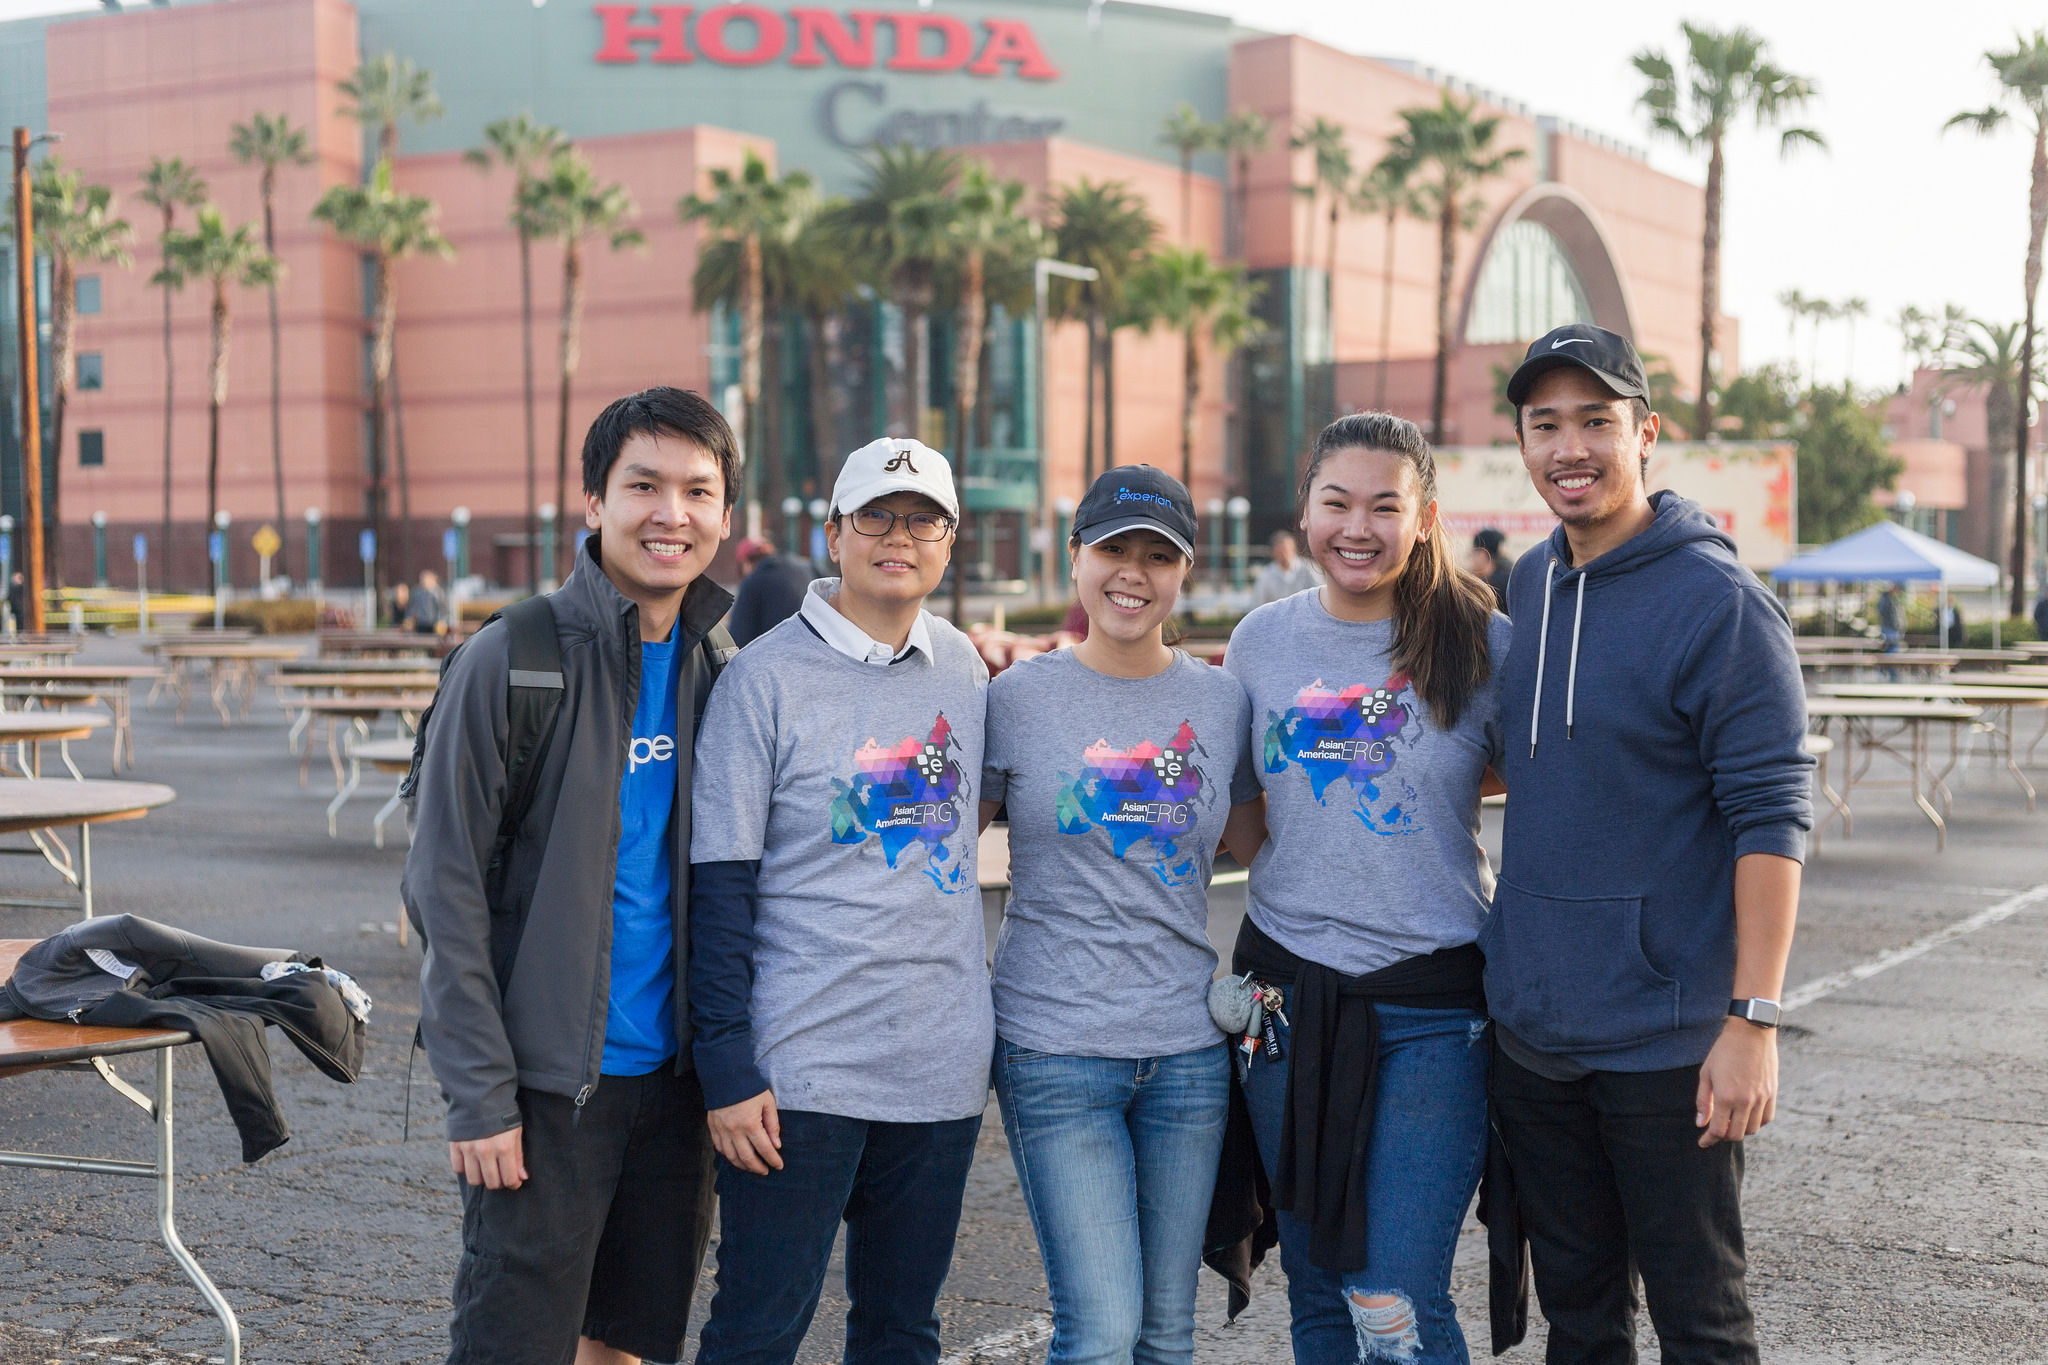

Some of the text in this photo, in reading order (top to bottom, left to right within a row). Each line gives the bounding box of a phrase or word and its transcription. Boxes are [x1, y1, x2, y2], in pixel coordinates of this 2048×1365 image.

[594, 3, 1060, 81] HONDA
[815, 79, 1065, 150] Center
[884, 450, 919, 475] A
[1119, 492, 1172, 508] experian
[628, 734, 675, 774] pe
[1297, 740, 1385, 762] American ERG
[1318, 740, 1343, 749] Asian
[875, 802, 952, 829] American ERG
[894, 806, 915, 816] Asian
[1101, 803, 1188, 824] American ERG
[1122, 802, 1148, 812] Asian
